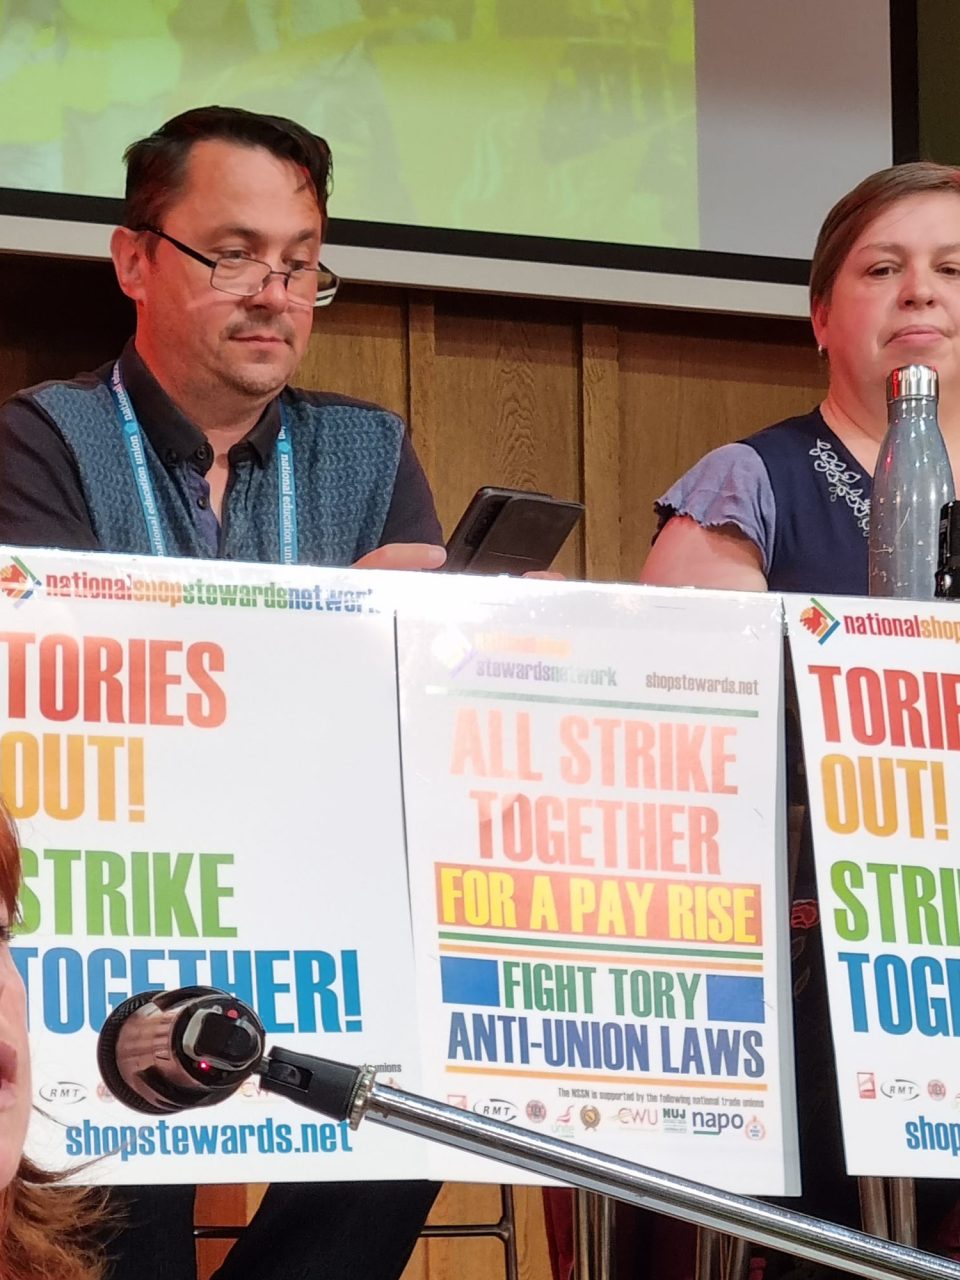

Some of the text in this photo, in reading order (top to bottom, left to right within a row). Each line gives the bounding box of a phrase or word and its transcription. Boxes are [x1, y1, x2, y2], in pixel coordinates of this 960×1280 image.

[130, 435, 143, 464] union
[138, 467, 155, 514] education
[281, 454, 292, 494] national
[283, 496, 294, 543] education
[645, 672, 759, 696] shopstewards.net
[450, 709, 738, 795] ALL STRIKE
[0, 731, 145, 822] OUT!
[820, 754, 949, 840] OUT!
[470, 790, 720, 875] TOGETHER
[13, 847, 238, 938] STRIKE
[441, 868, 755, 944] FOR A PAY RISE
[831, 860, 960, 947] STRI
[503, 961, 702, 1020] FIGHT TORY
[447, 1012, 765, 1077] ANTI-UNION LAWS
[50, 1088, 80, 1097] RMT
[483, 1105, 510, 1116] RMT
[558, 1087, 570, 1098] The
[646, 1092, 658, 1102] the
[890, 1085, 914, 1095] RMT
[618, 1107, 658, 1125] CWU
[663, 1108, 686, 1119] NUJ
[692, 1110, 744, 1134] napo
[66, 1118, 353, 1161] shopstewards.net
